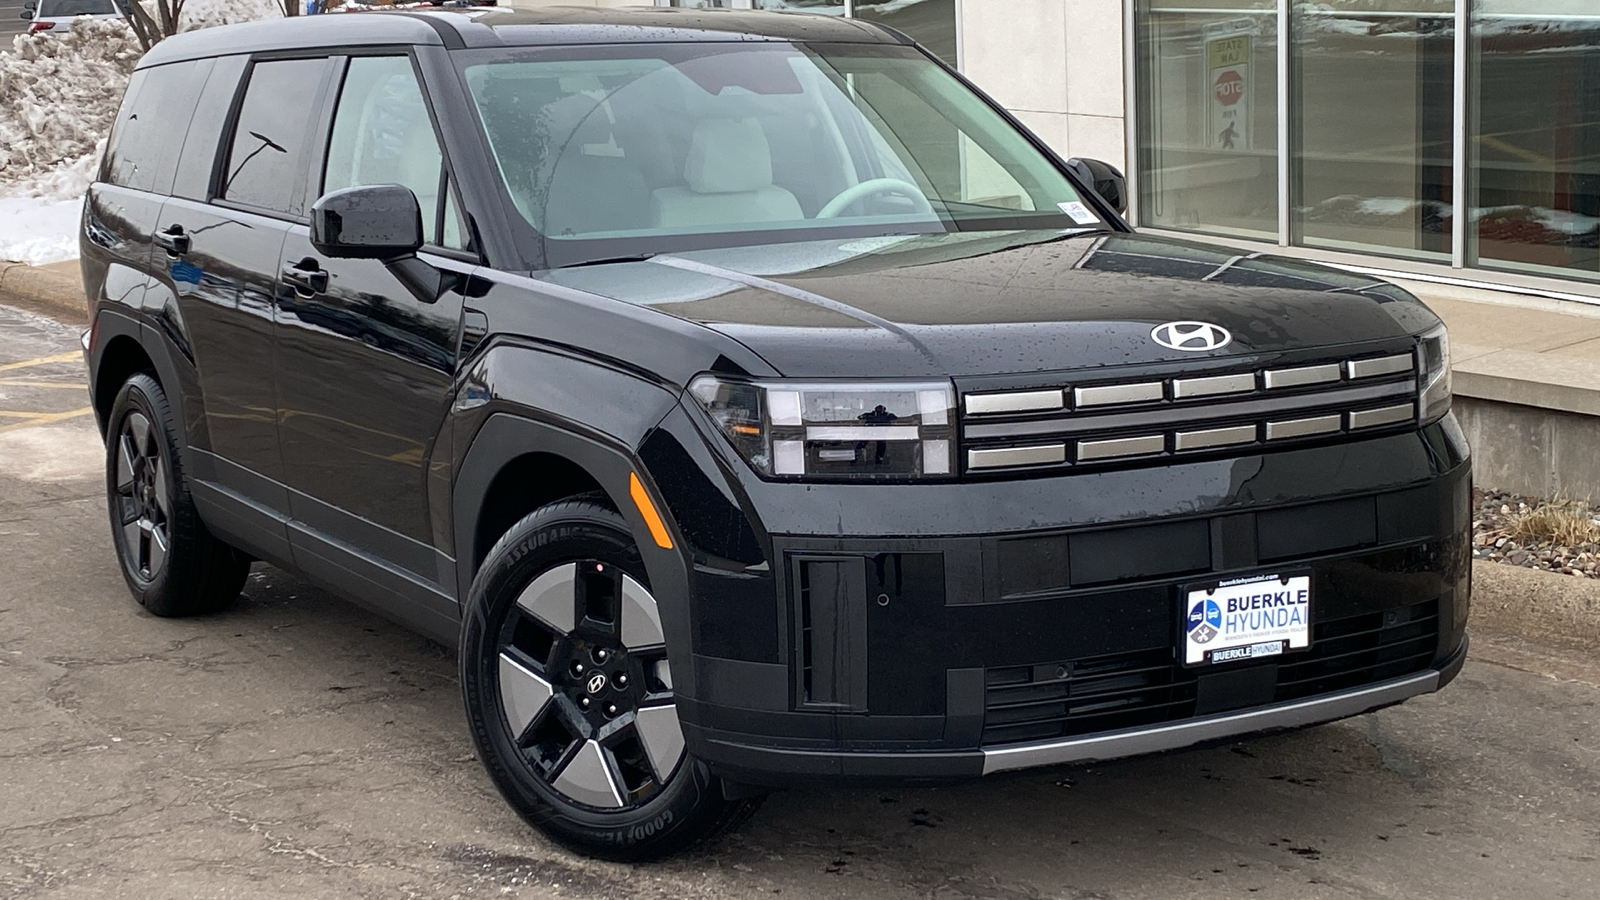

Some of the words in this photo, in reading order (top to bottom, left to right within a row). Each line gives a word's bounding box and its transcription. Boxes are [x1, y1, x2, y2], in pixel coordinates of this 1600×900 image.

[1219, 574, 1279, 586] buerklehyundai.com
[1227, 590, 1308, 613] BUERKLE
[1226, 606, 1307, 633] HYUNDAI
[1213, 646, 1252, 661] BUERKLE
[1252, 642, 1281, 655] HYUNDAI
[586, 809, 674, 844] GOODYE
